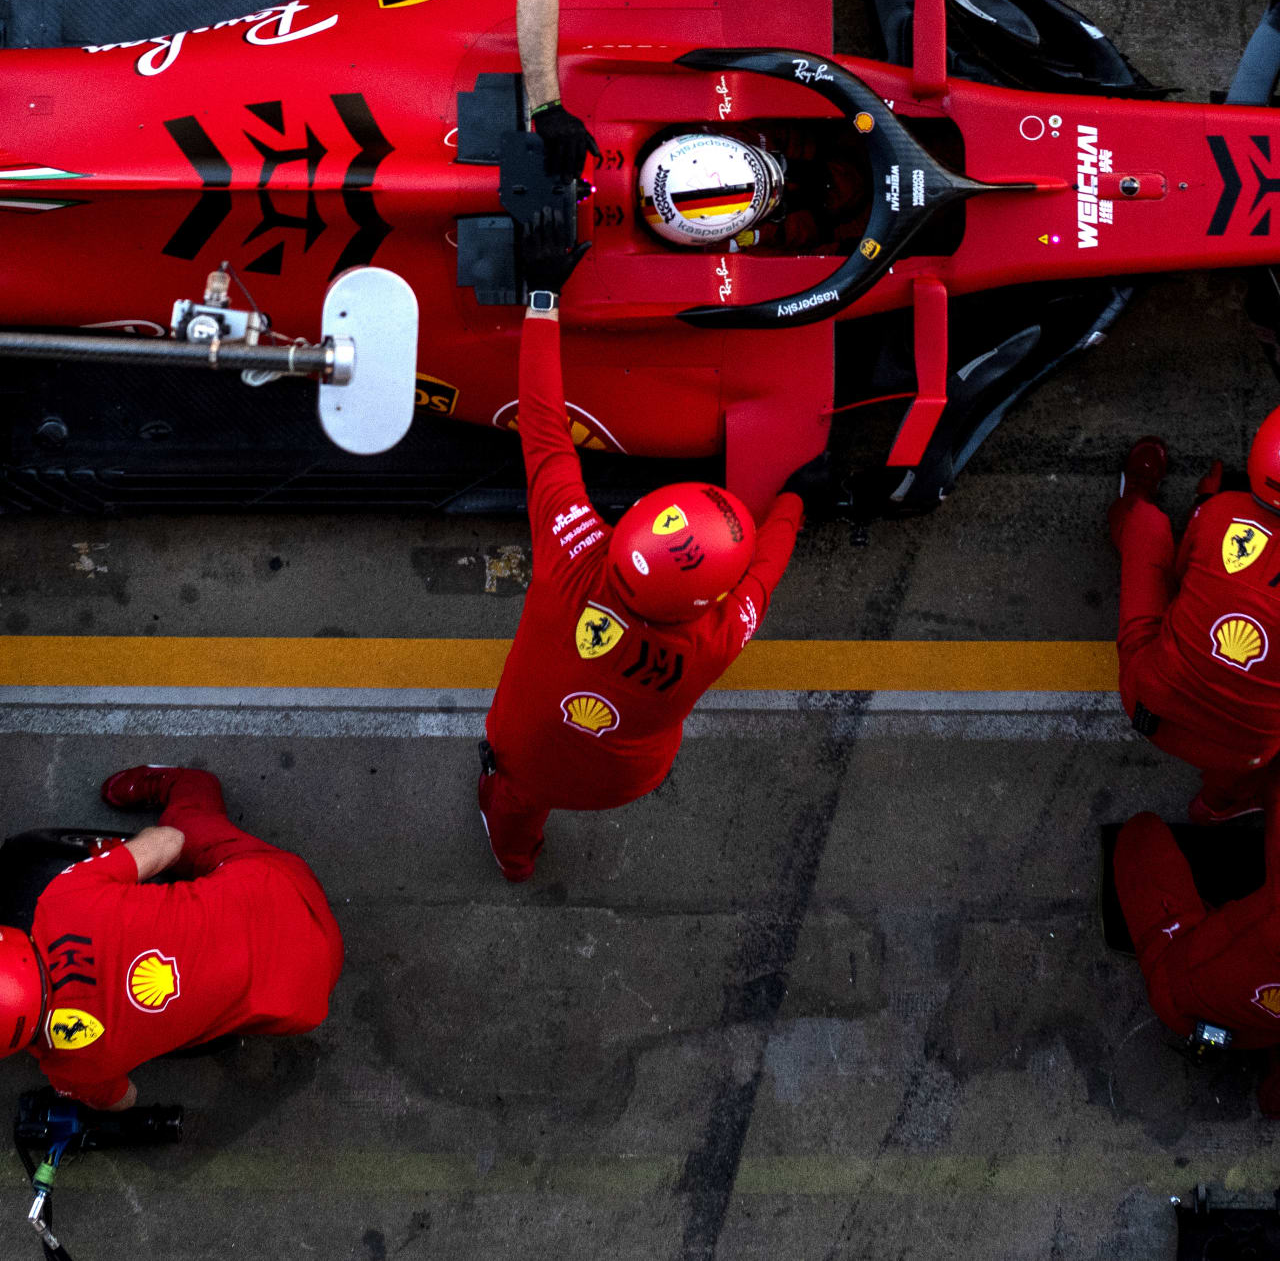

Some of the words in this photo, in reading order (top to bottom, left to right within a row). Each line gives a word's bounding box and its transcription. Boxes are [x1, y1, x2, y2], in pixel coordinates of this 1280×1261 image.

[792, 59, 835, 83] Ray-Ban
[716, 75, 732, 120] Ray-Ban
[891, 165, 900, 211] WEICHAI
[1077, 125, 1098, 249] WEICHAI
[716, 257, 732, 302] Ray-Ban
[777, 290, 840, 317] kaspersky
[568, 530, 604, 559] HUBLOT
